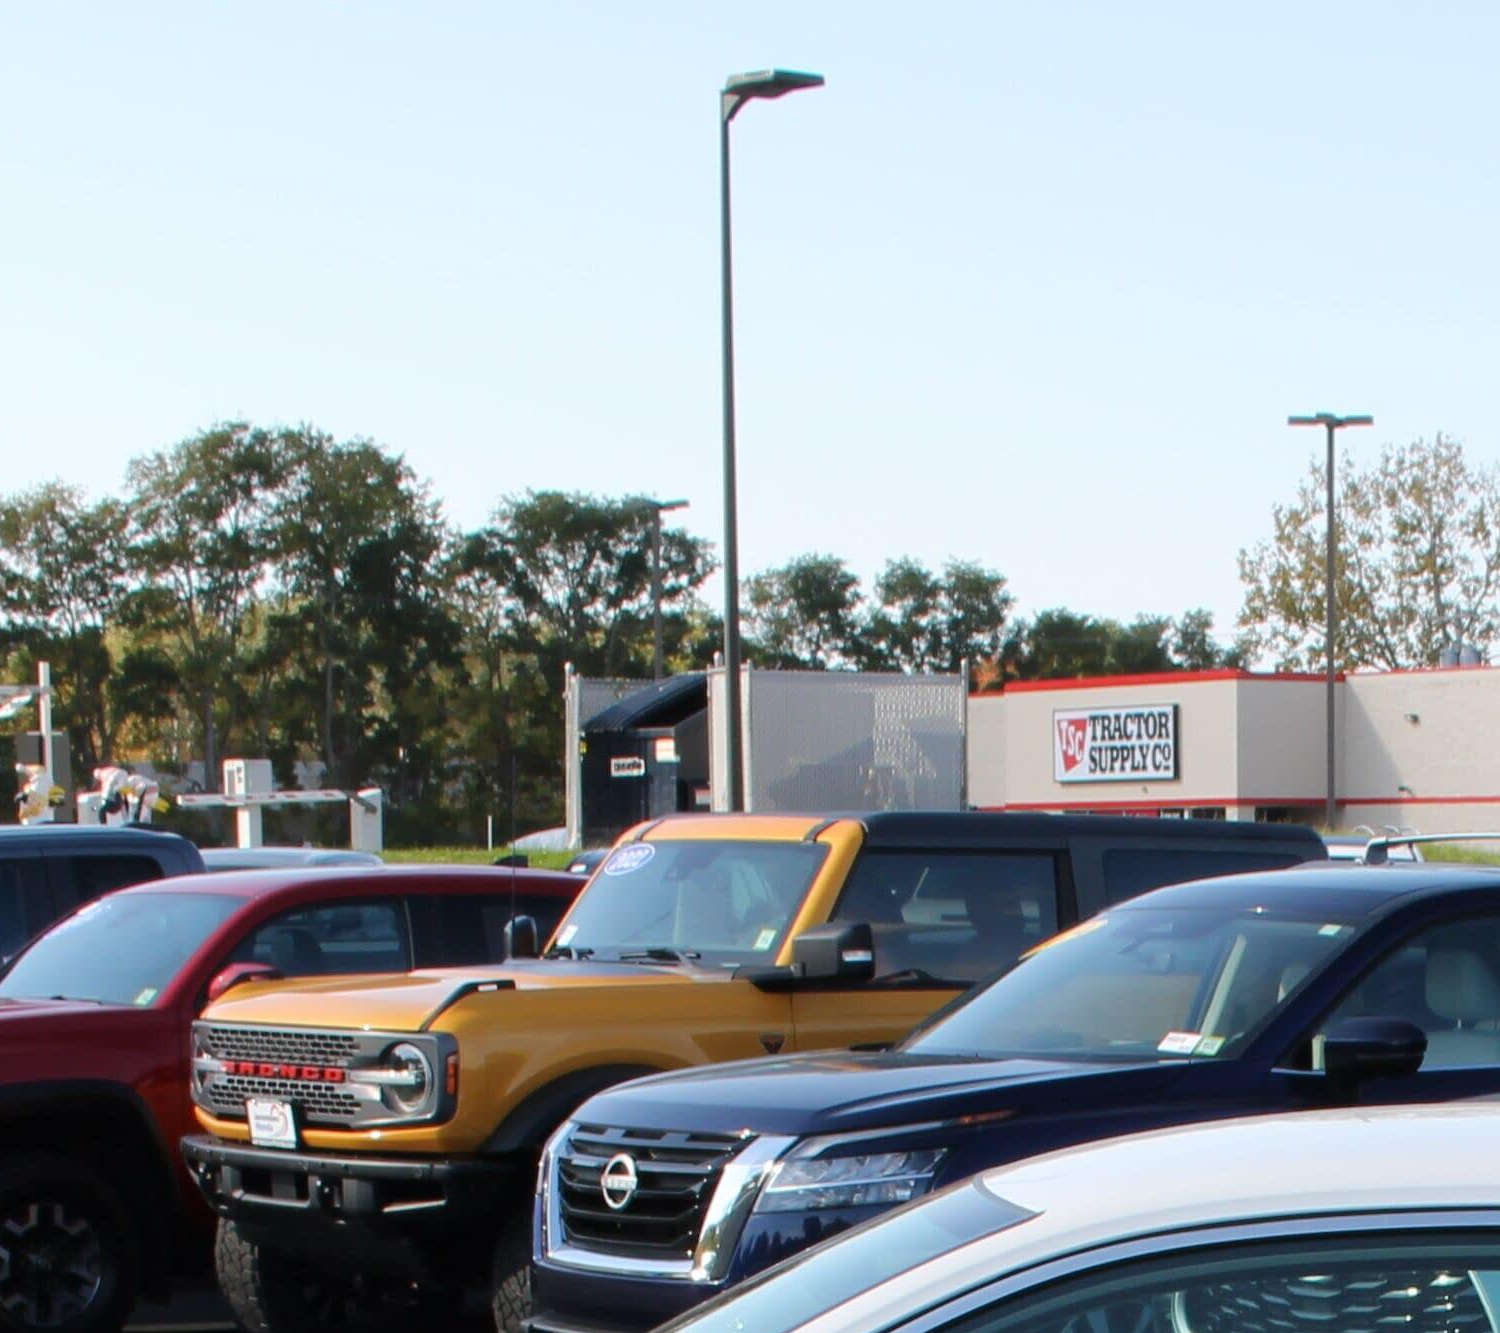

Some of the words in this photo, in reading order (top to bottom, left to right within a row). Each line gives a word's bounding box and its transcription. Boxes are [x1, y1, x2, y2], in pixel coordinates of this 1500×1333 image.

[1059, 720, 1084, 762] TSC
[1088, 711, 1170, 741] TRACTOR
[1088, 743, 1150, 773] SUPPLY
